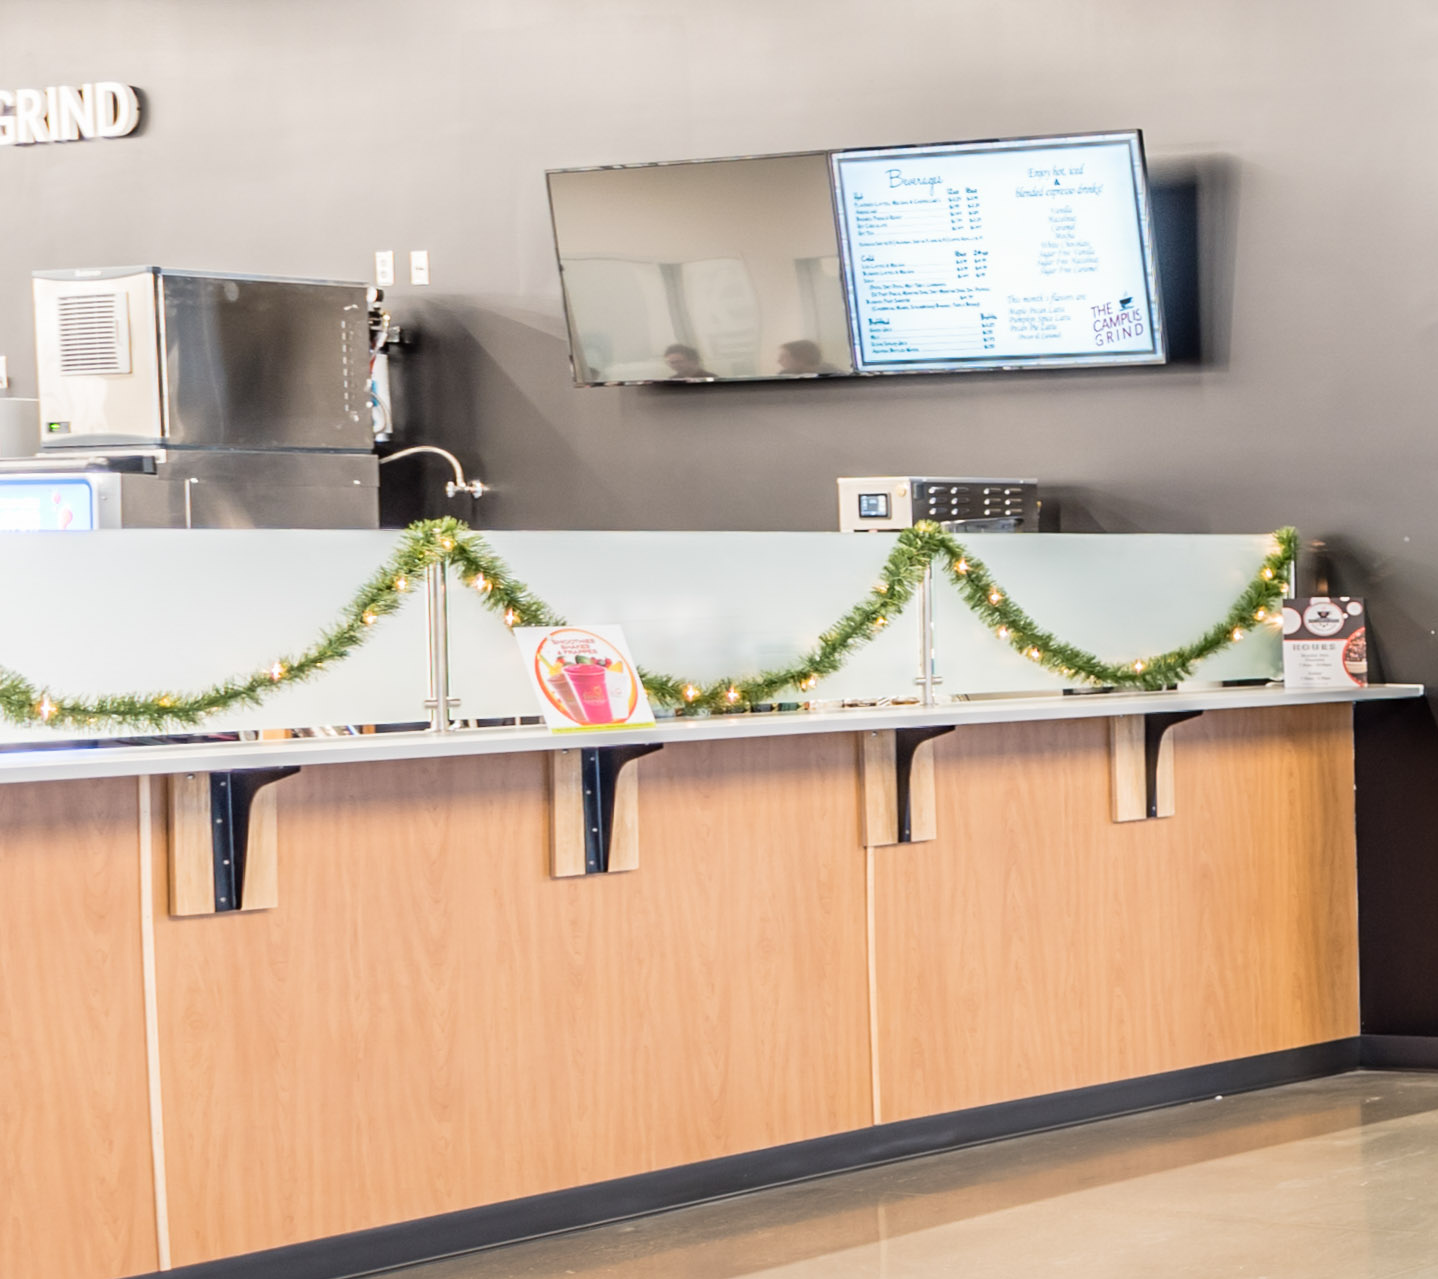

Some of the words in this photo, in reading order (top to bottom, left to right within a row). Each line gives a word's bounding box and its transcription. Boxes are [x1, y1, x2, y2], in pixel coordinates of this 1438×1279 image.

[0, 81, 139, 146] GRIND
[885, 169, 943, 196] Beverages
[1091, 302, 1113, 319] THE
[1093, 308, 1142, 333] CAMPUS
[1095, 323, 1144, 347] GRIND
